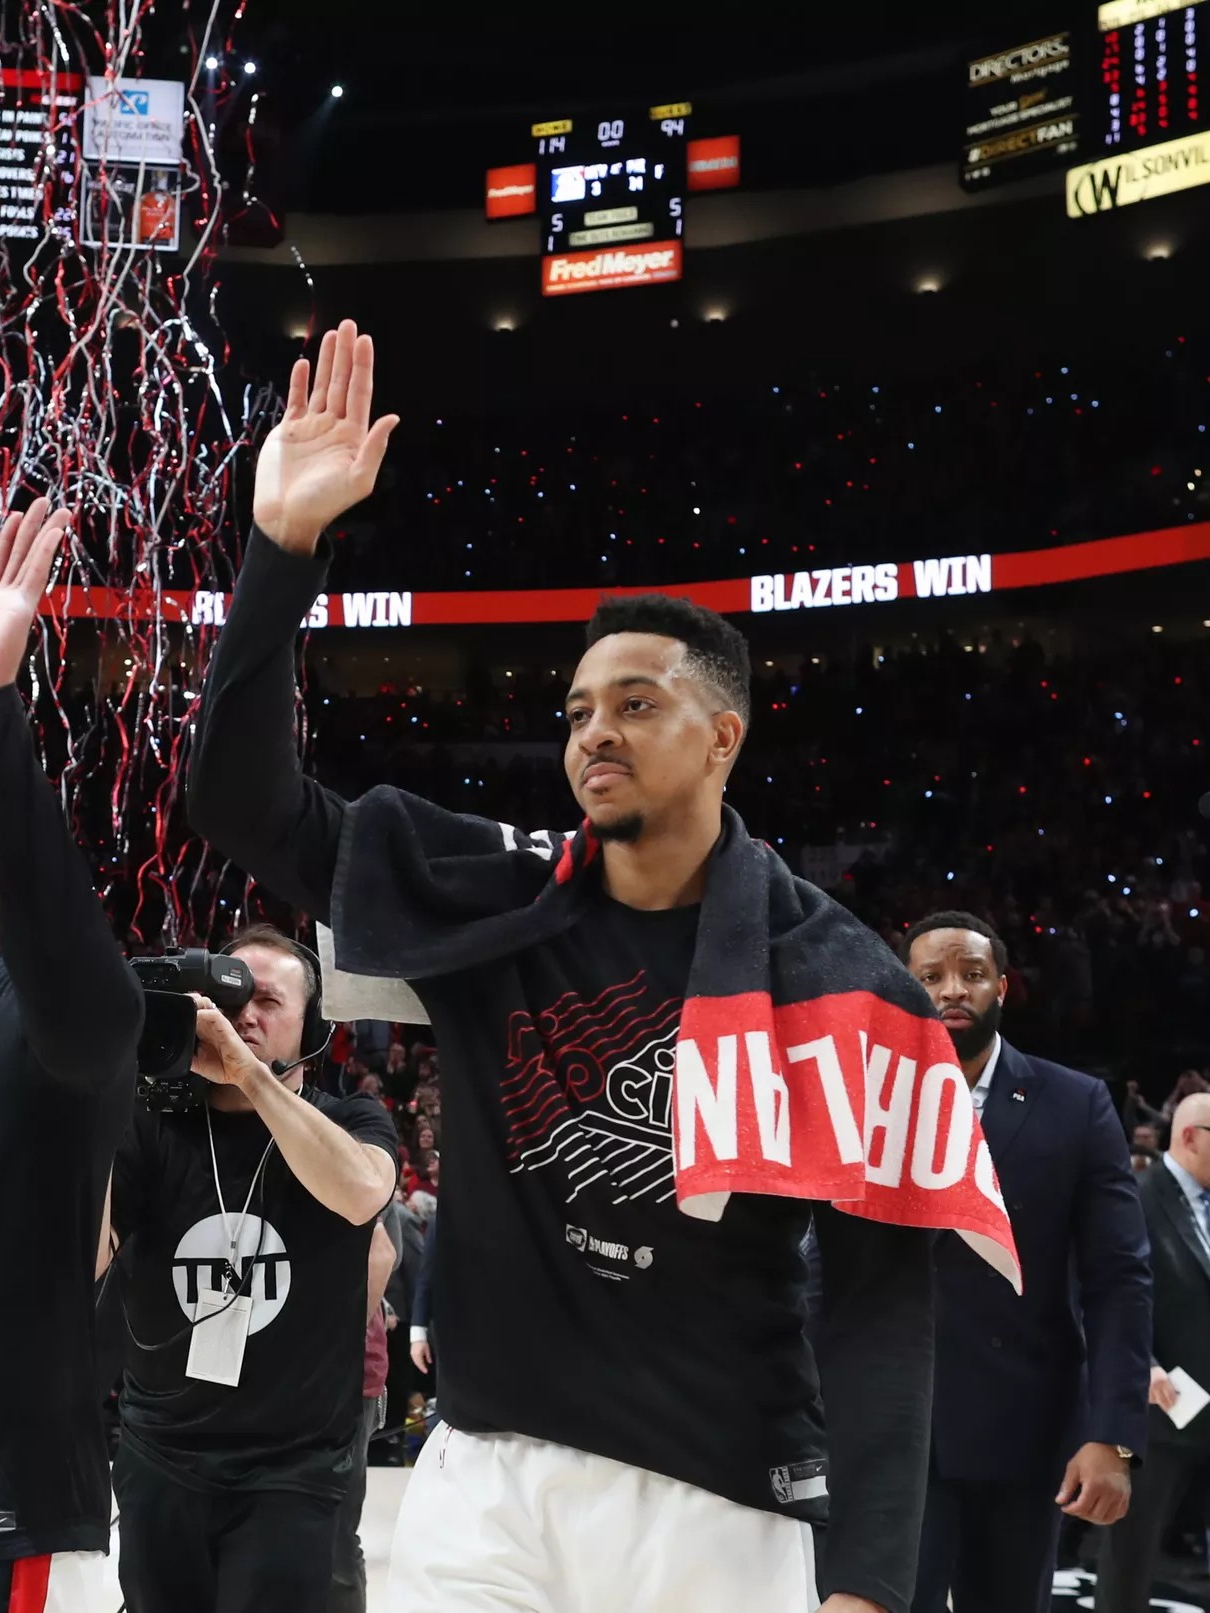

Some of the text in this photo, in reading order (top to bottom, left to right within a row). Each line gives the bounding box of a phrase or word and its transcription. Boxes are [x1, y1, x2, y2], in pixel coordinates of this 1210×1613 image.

[661, 118, 685, 137] 94
[751, 554, 992, 613] BLAZERS WIN
[342, 591, 412, 628] WIN
[172, 1252, 291, 1304] TNT
